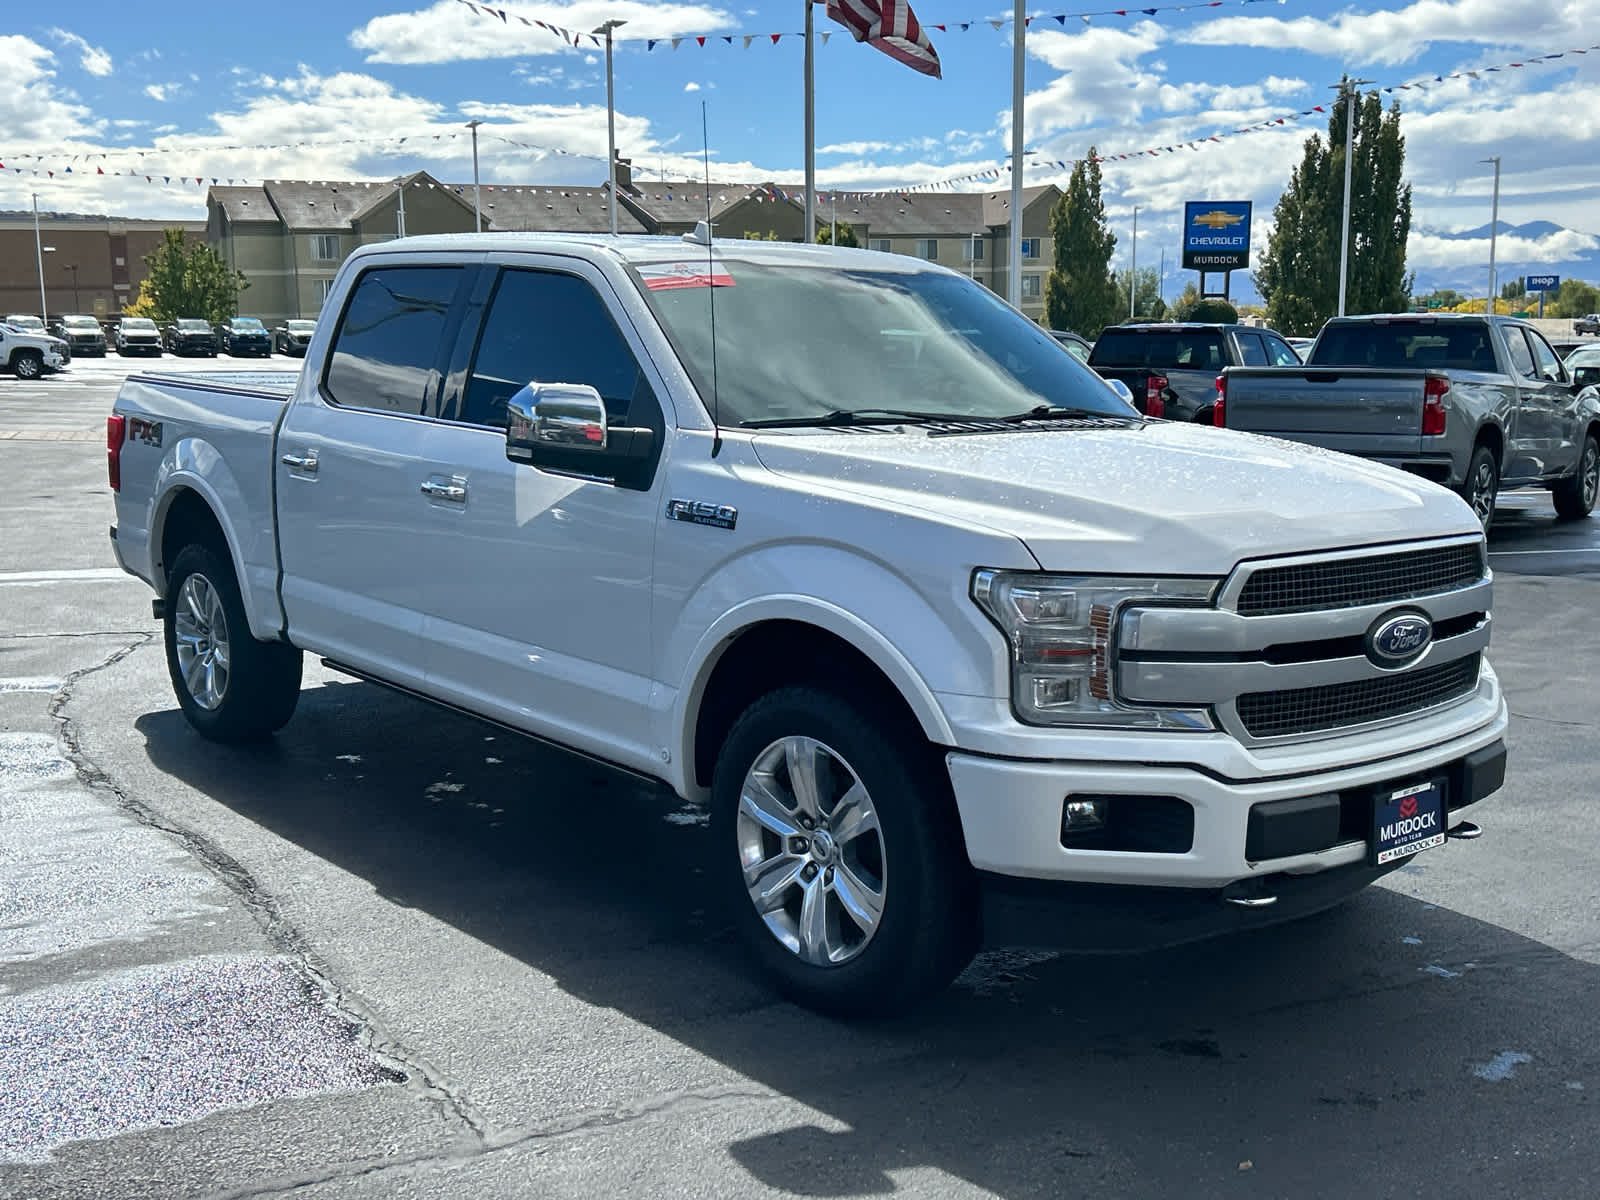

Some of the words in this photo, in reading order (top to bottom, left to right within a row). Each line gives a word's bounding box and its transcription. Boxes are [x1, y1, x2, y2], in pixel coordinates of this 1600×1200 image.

[1190, 237, 1244, 245] CHEVROLET
[1193, 256, 1239, 264] MURDOCK
[1390, 625, 1422, 650] Ford
[1380, 810, 1436, 842] MURDOCK
[1394, 836, 1408, 845] AUTO
[1408, 832, 1422, 841] TEAM
[1393, 839, 1431, 857] MURDOCK
